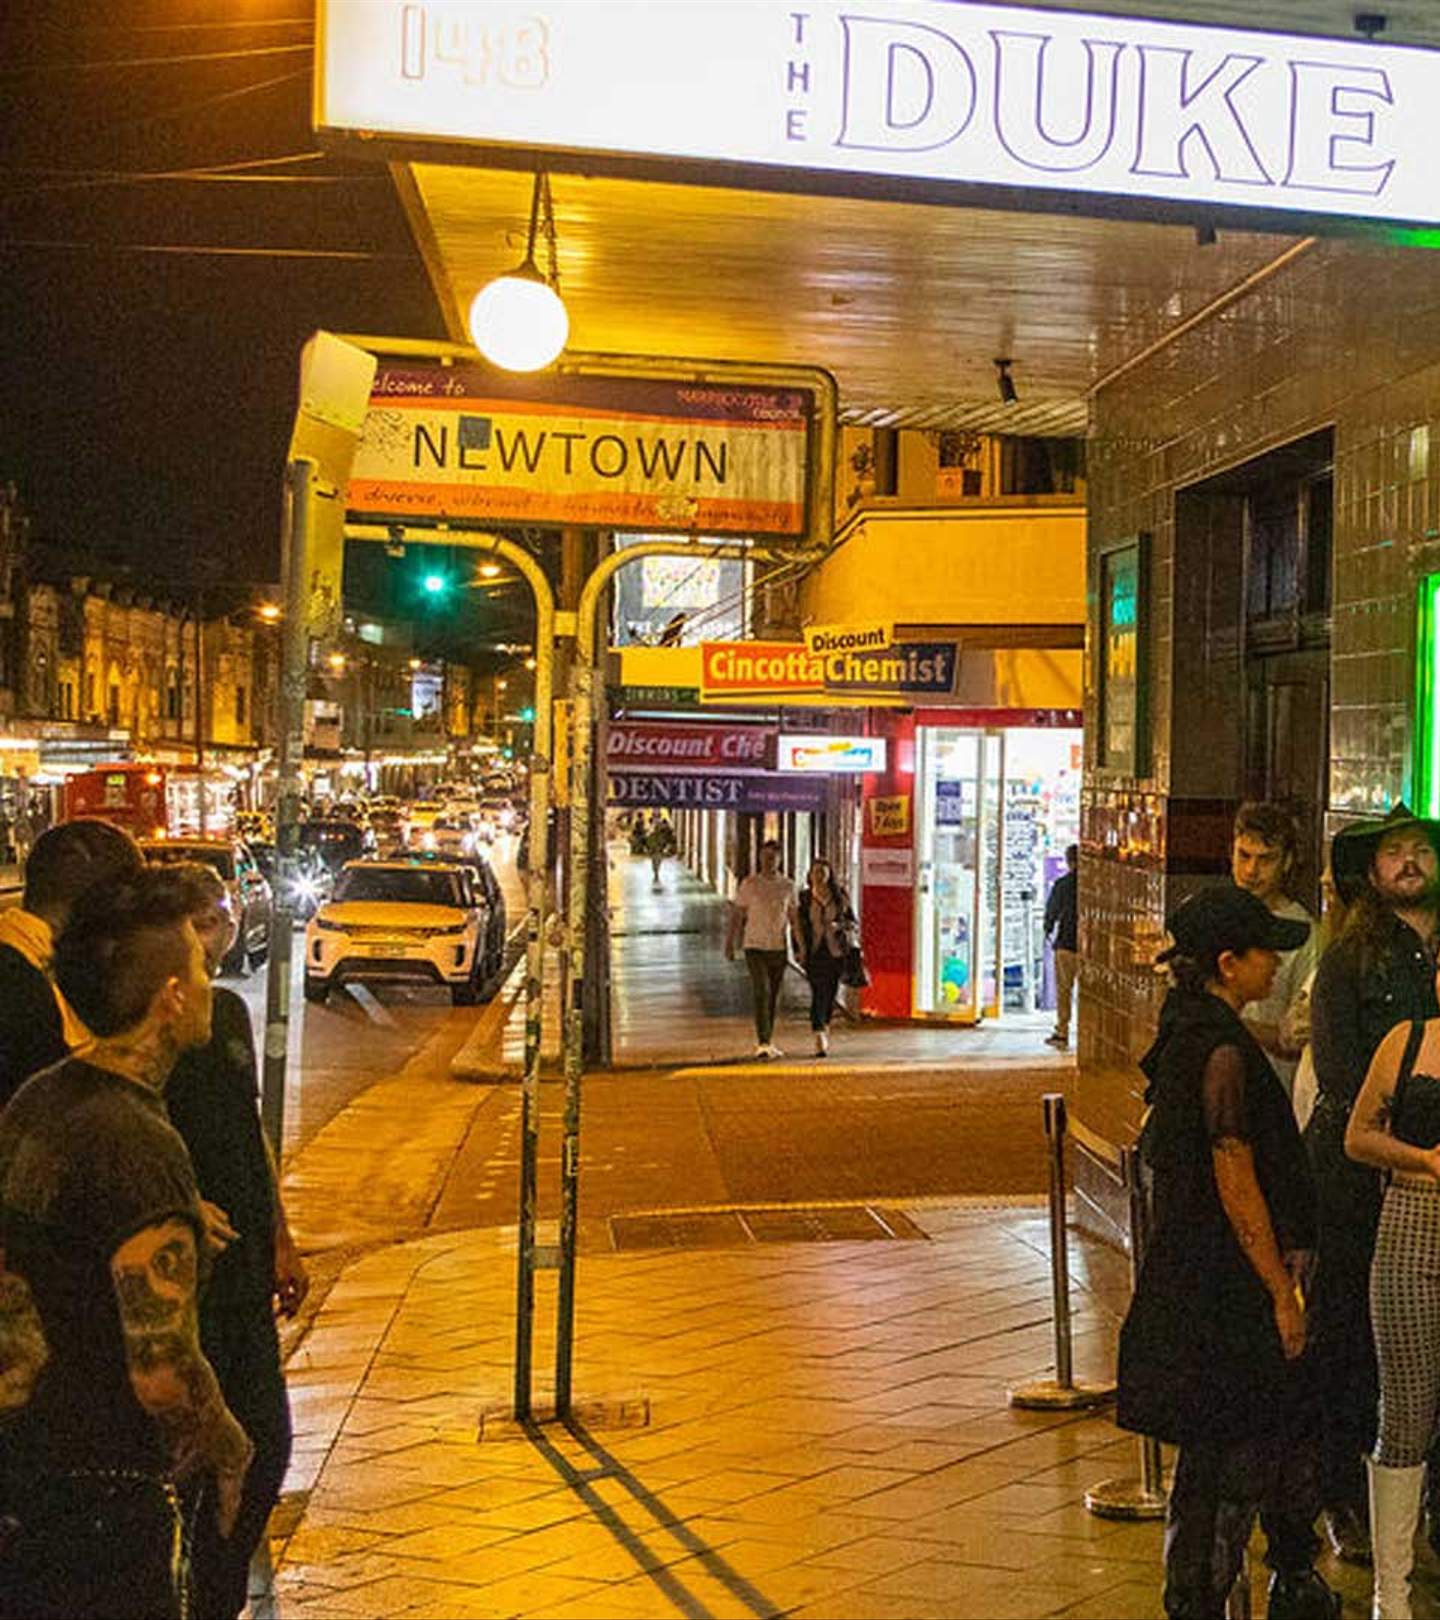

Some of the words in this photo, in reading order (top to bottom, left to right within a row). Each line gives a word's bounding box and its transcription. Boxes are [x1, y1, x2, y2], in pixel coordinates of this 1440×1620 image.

[401, 4, 549, 89] 148
[834, 15, 1396, 196] DUKE
[372, 371, 434, 395] elcome
[811, 627, 886, 652] Discount
[607, 731, 715, 757] Discount
[607, 775, 745, 802] DENTIST
